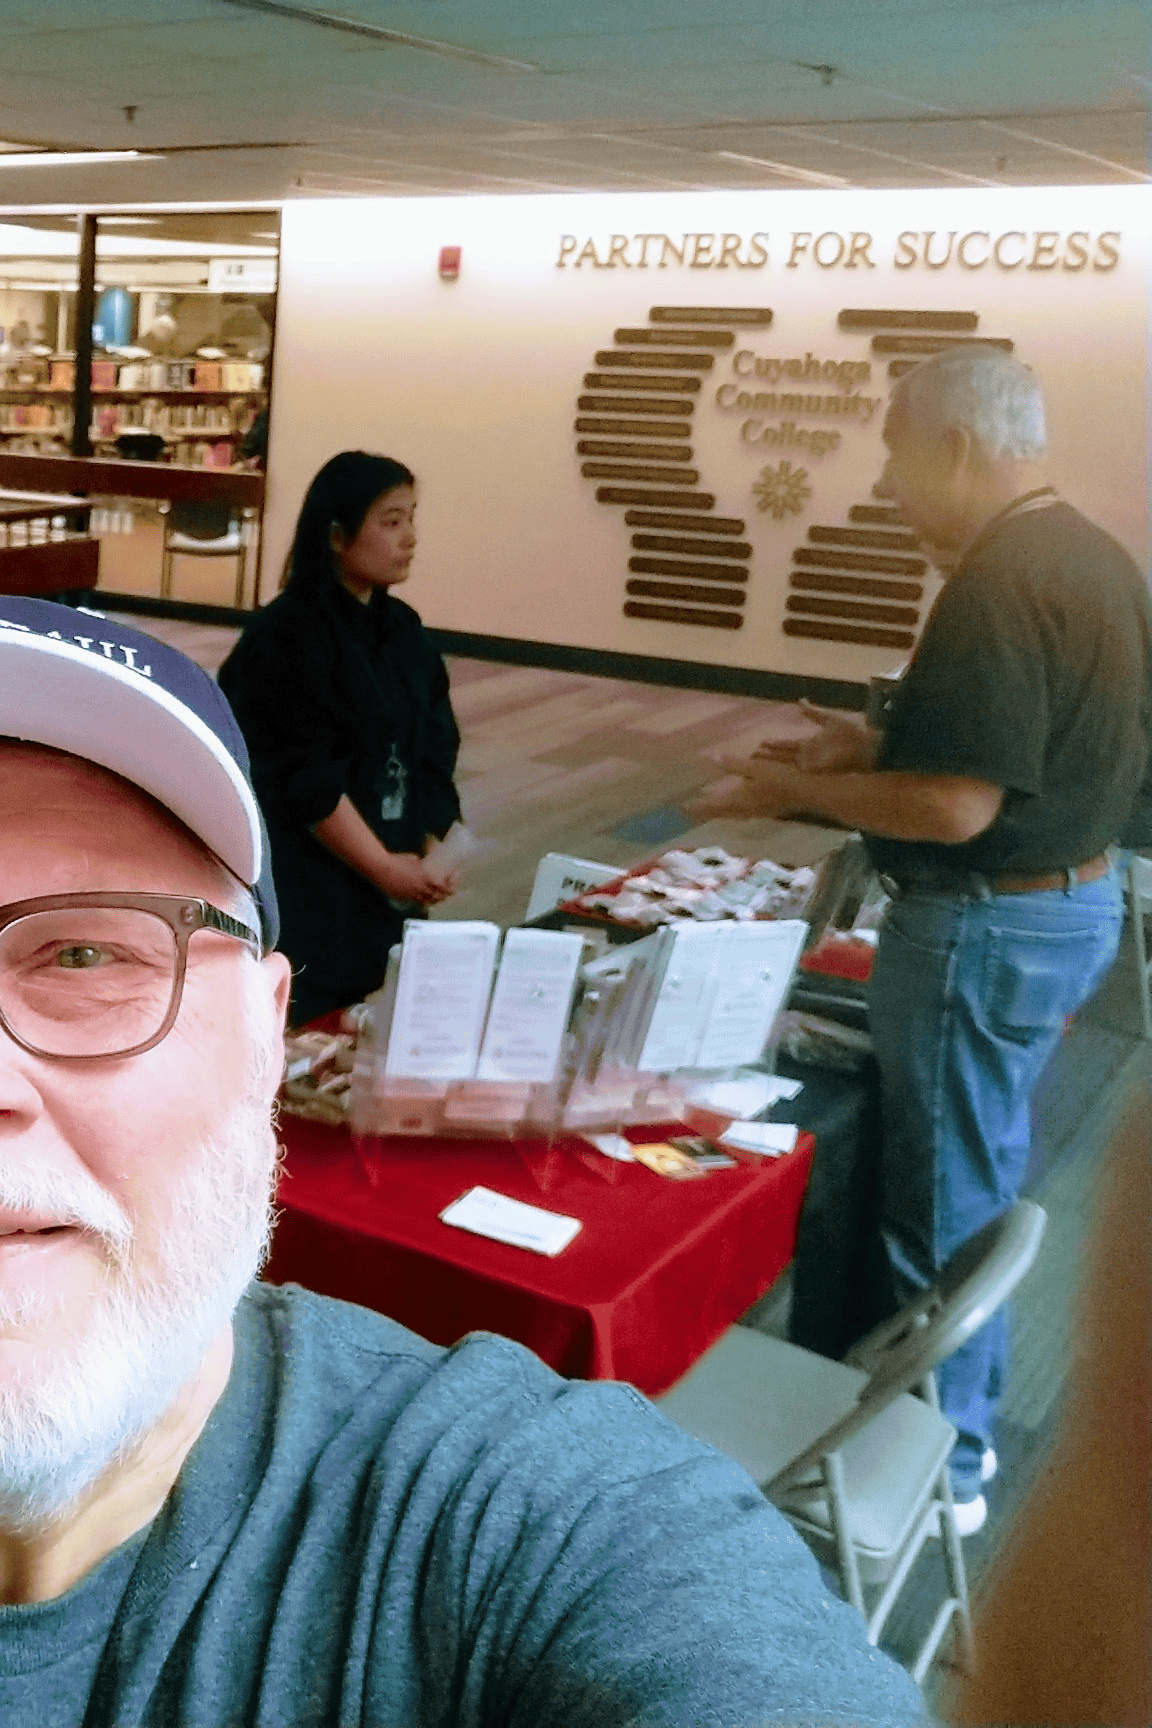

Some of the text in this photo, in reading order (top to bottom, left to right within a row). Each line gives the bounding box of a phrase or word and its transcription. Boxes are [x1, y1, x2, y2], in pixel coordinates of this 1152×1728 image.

[555, 230, 1122, 271] PARTNERS FOR SUCCESS
[733, 350, 872, 396] Cuyahoga
[715, 383, 882, 424] Community
[741, 418, 841, 457] College
